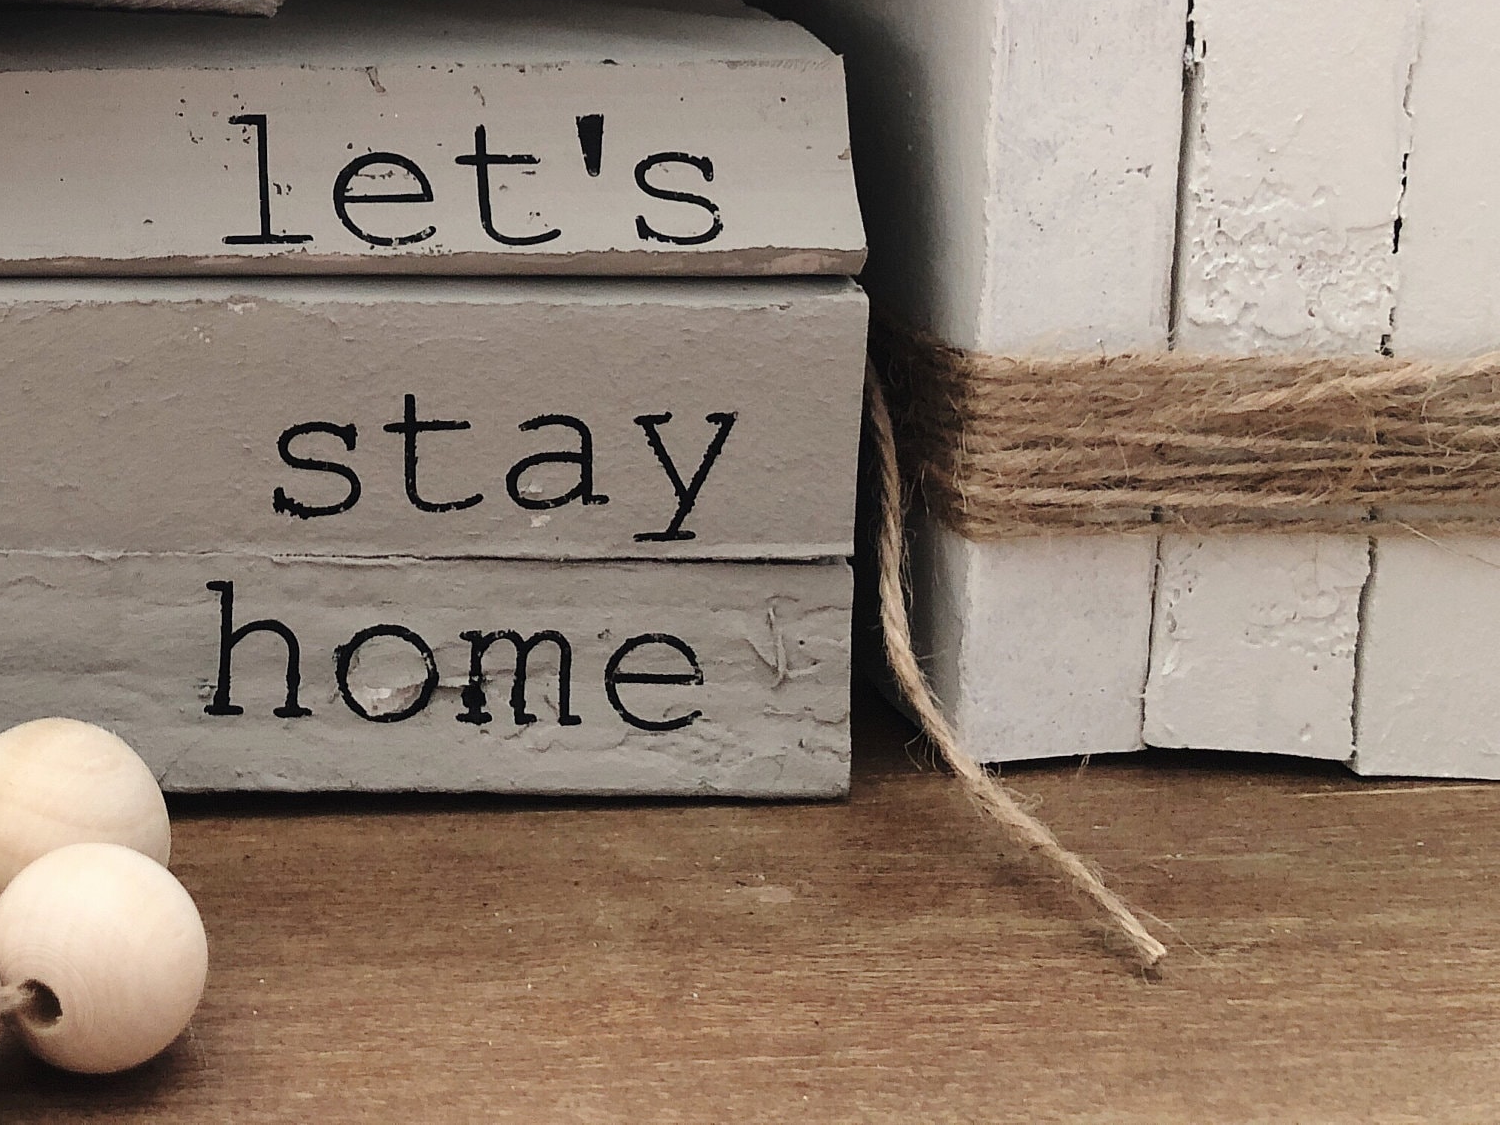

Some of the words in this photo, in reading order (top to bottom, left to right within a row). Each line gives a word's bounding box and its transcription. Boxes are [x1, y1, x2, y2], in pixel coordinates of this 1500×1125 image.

[223, 113, 725, 246] let's
[272, 393, 739, 542] stay
[203, 580, 705, 732] home
